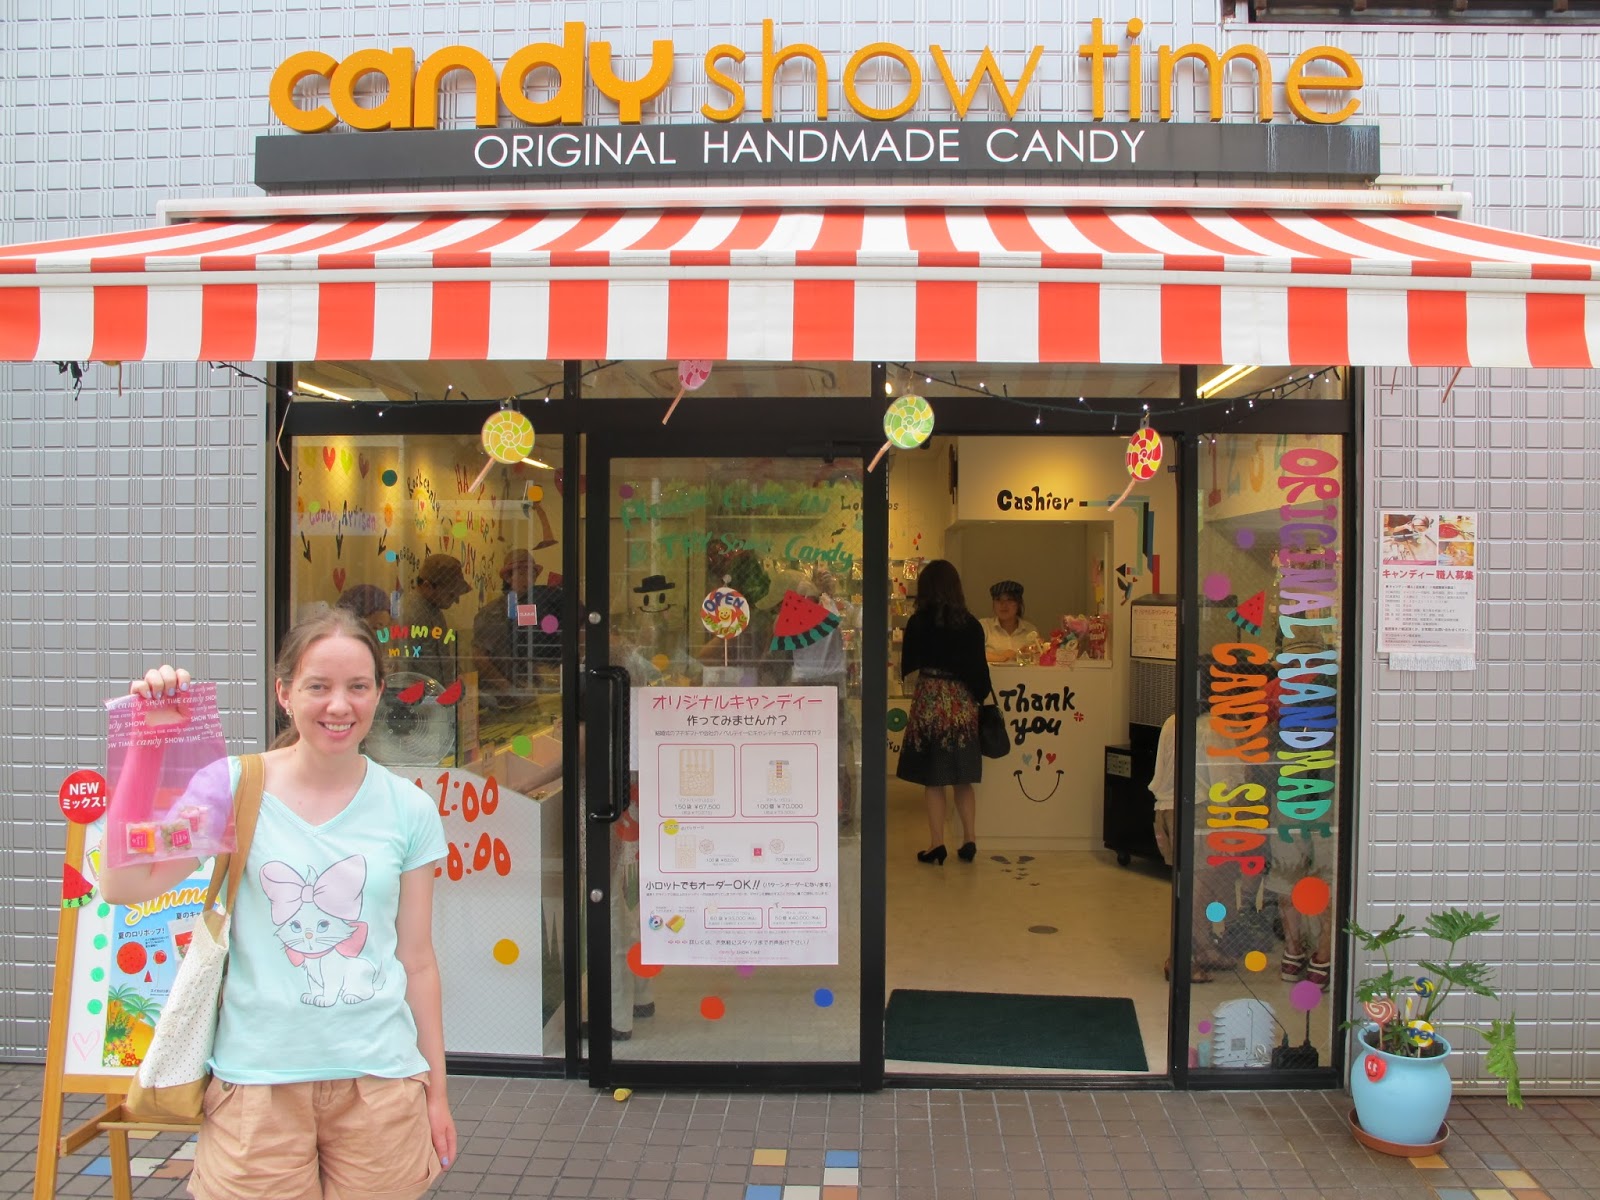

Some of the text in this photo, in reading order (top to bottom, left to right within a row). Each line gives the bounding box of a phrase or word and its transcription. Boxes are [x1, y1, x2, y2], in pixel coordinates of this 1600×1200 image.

[269, 18, 1363, 133] candy show time
[474, 128, 1146, 169] ORIGINAL HANDMADE CANDY
[997, 486, 1073, 512] Cashier
[785, 534, 854, 573] Candy
[704, 591, 745, 612] OPEN
[376, 624, 456, 645] ummer
[1276, 448, 1341, 843] ORIGINAL HANDMADE
[388, 645, 421, 658] mix
[652, 693, 823, 710] オリジナルキャンディー
[999, 683, 1076, 713] Thank
[1010, 714, 1062, 746] you
[1206, 642, 1271, 877] CANDY SHOP
[63, 796, 106, 809] ミックス!
[69, 781, 99, 796] NEW
[415, 771, 499, 823] 1:00
[434, 832, 512, 882] 0:00
[125, 887, 220, 926] Summe
